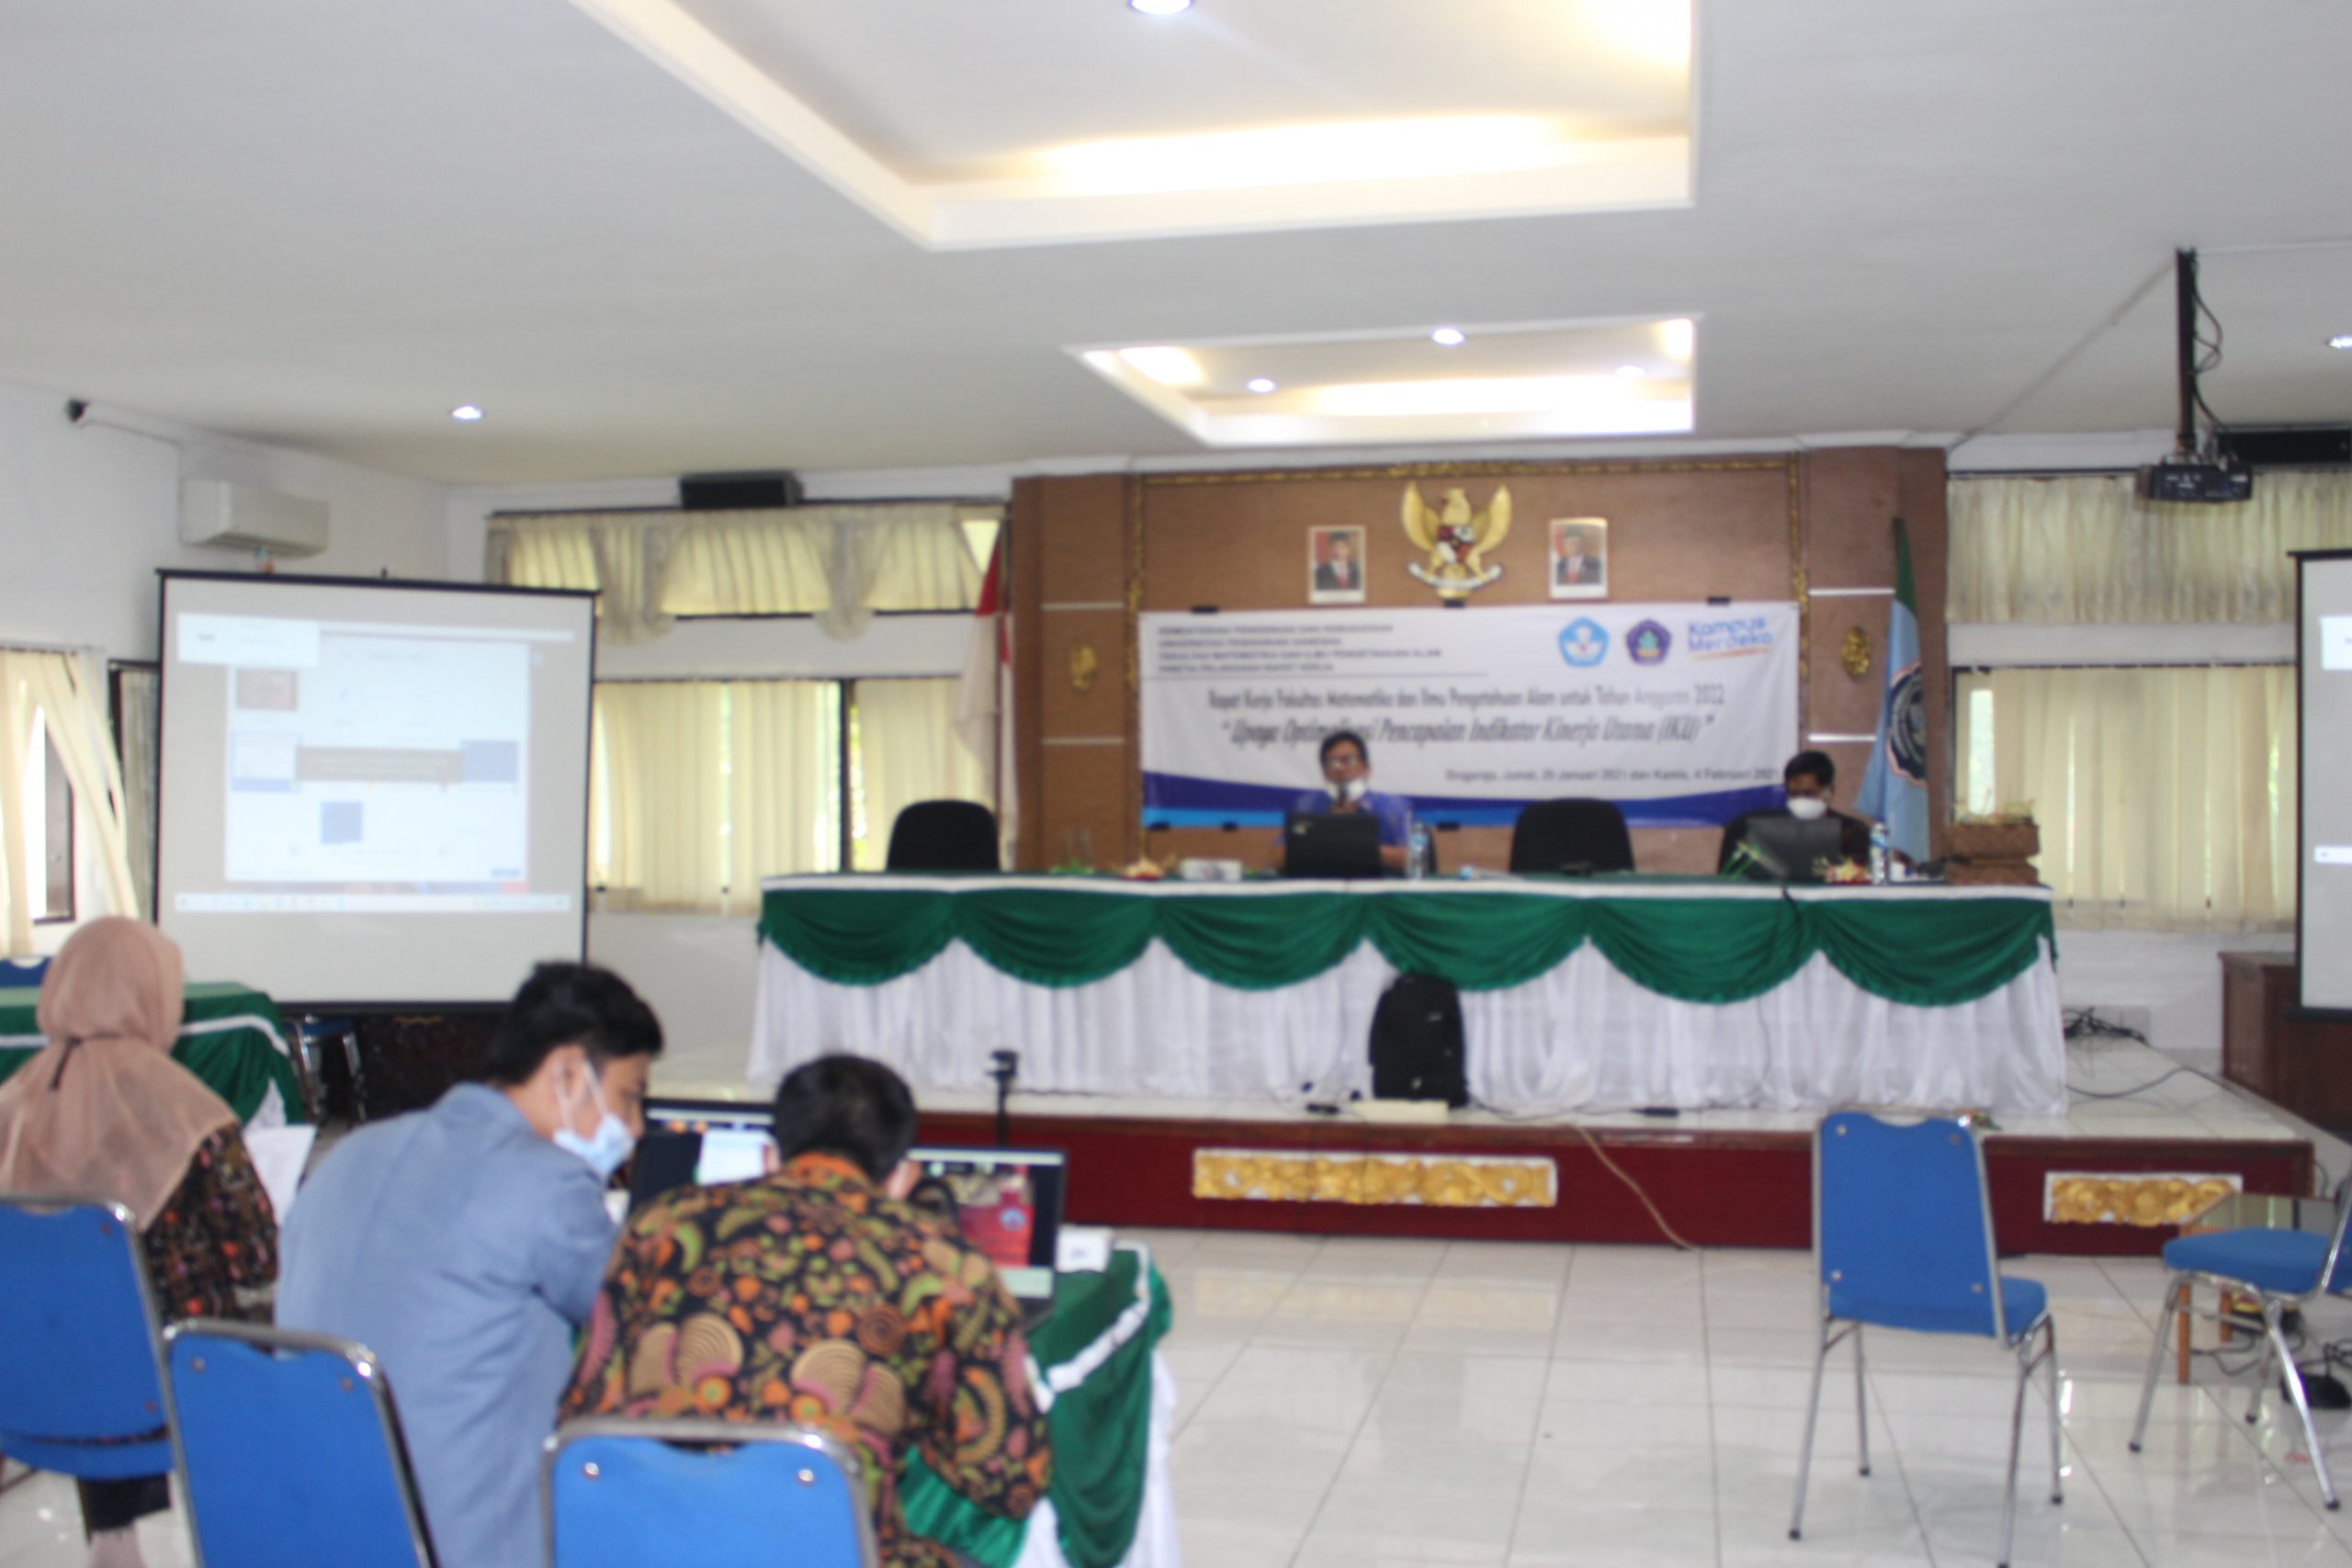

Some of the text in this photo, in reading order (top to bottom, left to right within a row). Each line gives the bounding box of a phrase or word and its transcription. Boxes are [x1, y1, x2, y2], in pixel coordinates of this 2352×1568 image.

[1689, 617, 1766, 637] Kampus
[1689, 632, 1772, 651] Merdeka
[1328, 687, 1393, 707] Matematika
[1528, 685, 1555, 706] Alam
[1380, 716, 1466, 750] Pencapaian
[1469, 716, 1541, 741] Indikator
[1543, 716, 1600, 749] Kinerja
[1602, 715, 1656, 741] Utama
